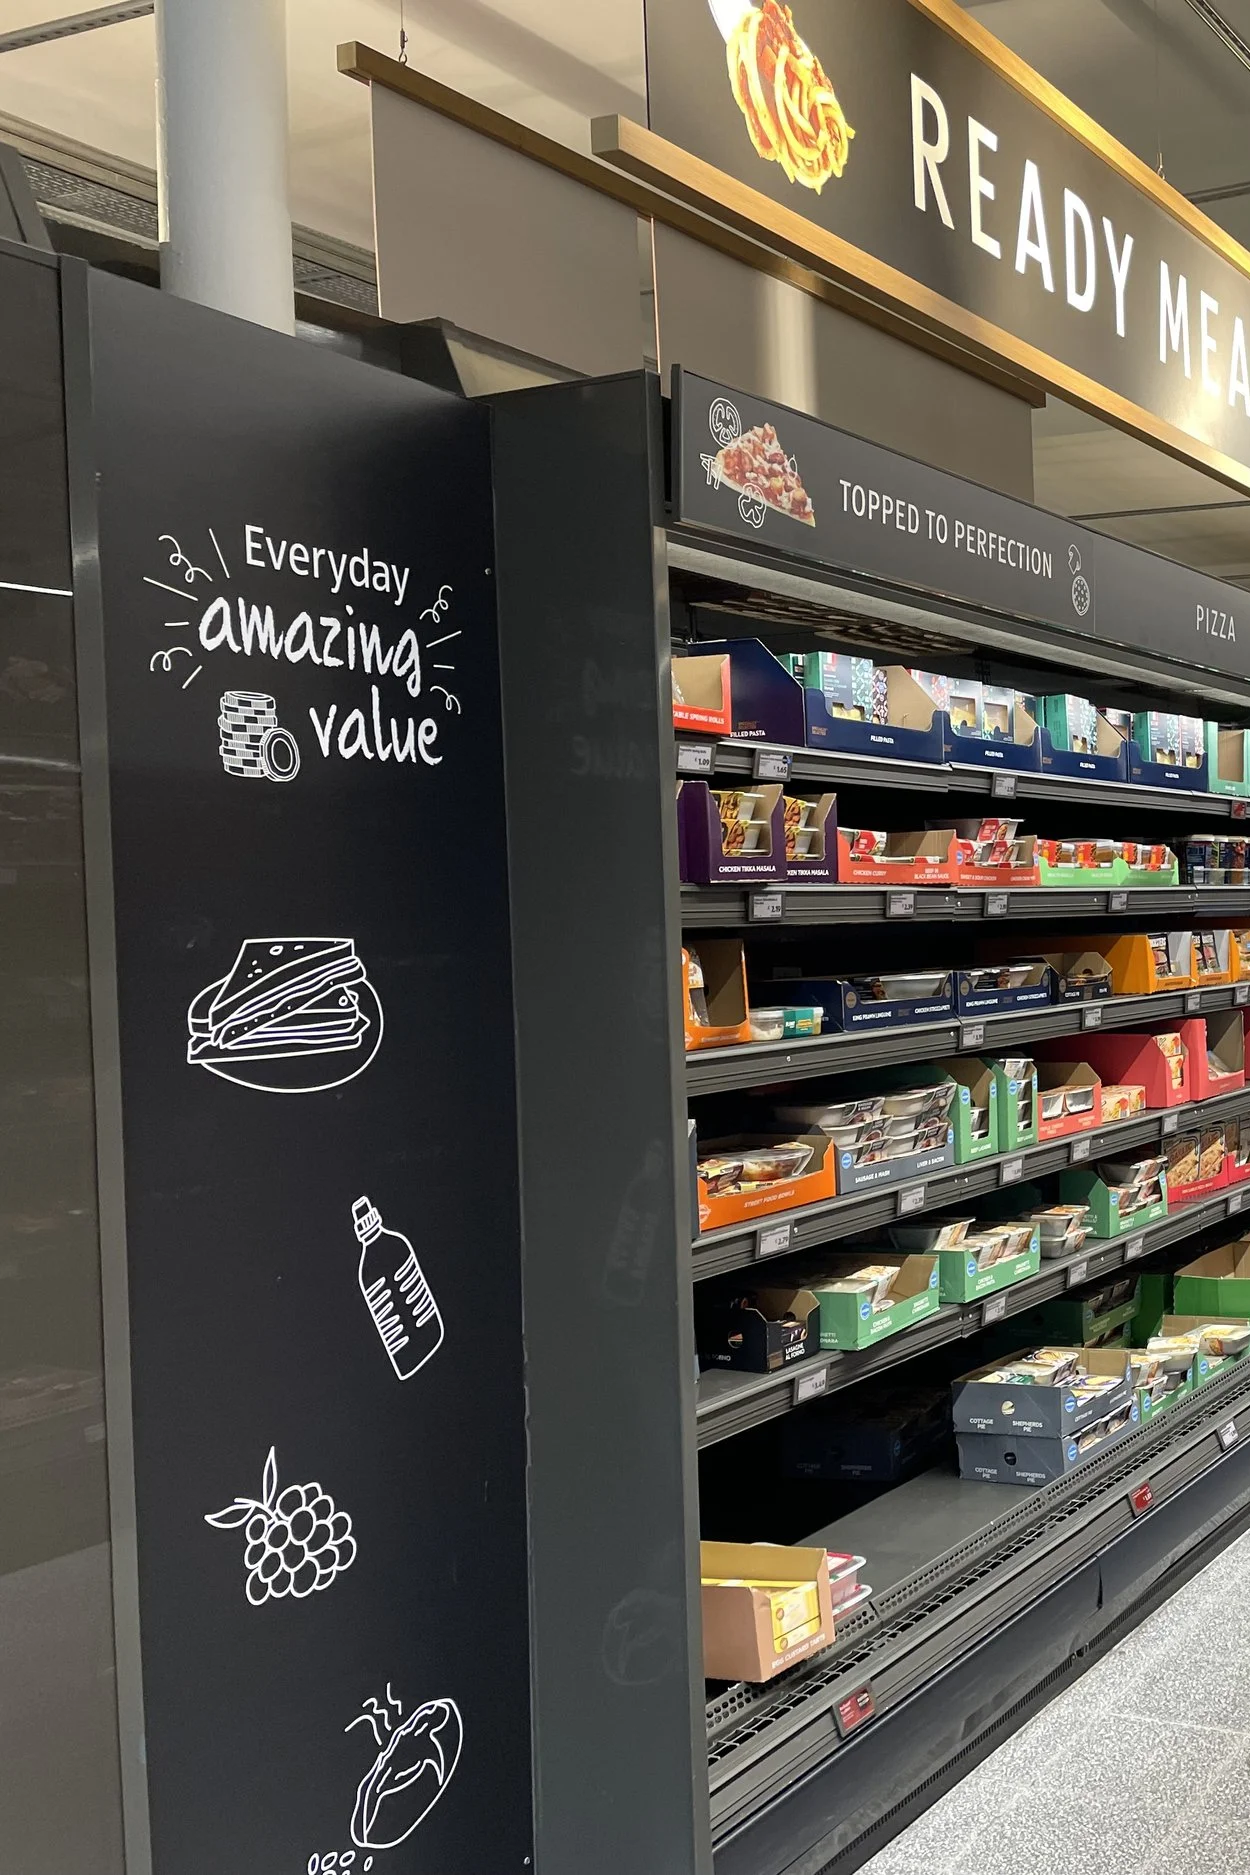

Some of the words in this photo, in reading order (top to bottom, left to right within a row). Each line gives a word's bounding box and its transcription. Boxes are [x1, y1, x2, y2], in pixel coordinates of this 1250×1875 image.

[910, 72, 1134, 339] READY
[839, 479, 920, 535] TOPPED
[925, 508, 949, 545] TO
[954, 519, 1053, 579] PERFECTION
[244, 525, 409, 606] Everyday
[1196, 604, 1236, 642] PIZZA
[198, 595, 422, 697] amazing
[673, 711, 689, 720] ABLE
[690, 713, 708, 722] SPRING
[708, 716, 725, 725] ROLLS
[309, 685, 443, 766] value
[719, 865, 741, 873] CHICKEN
[853, 869, 871, 877] CHICKEN
[931, 1156, 944, 1164] BACON
[855, 1172, 874, 1184] SAUSAGE
[743, 1198, 763, 1209] STREET
[763, 1194, 778, 1203] FOOD
[785, 1342, 804, 1355] LASAGNE
[785, 1353, 792, 1361] AL
[791, 1348, 806, 1359] FORNO
[969, 1417, 994, 1425] COTTAGE
[1012, 1420, 1043, 1428] SHEPHERDS
[975, 1466, 998, 1475] COTTAGE
[1015, 1471, 1046, 1479] SHEPHERDS
[771, 1656, 785, 1670] EGG
[785, 1643, 810, 1661] CUSTARD
